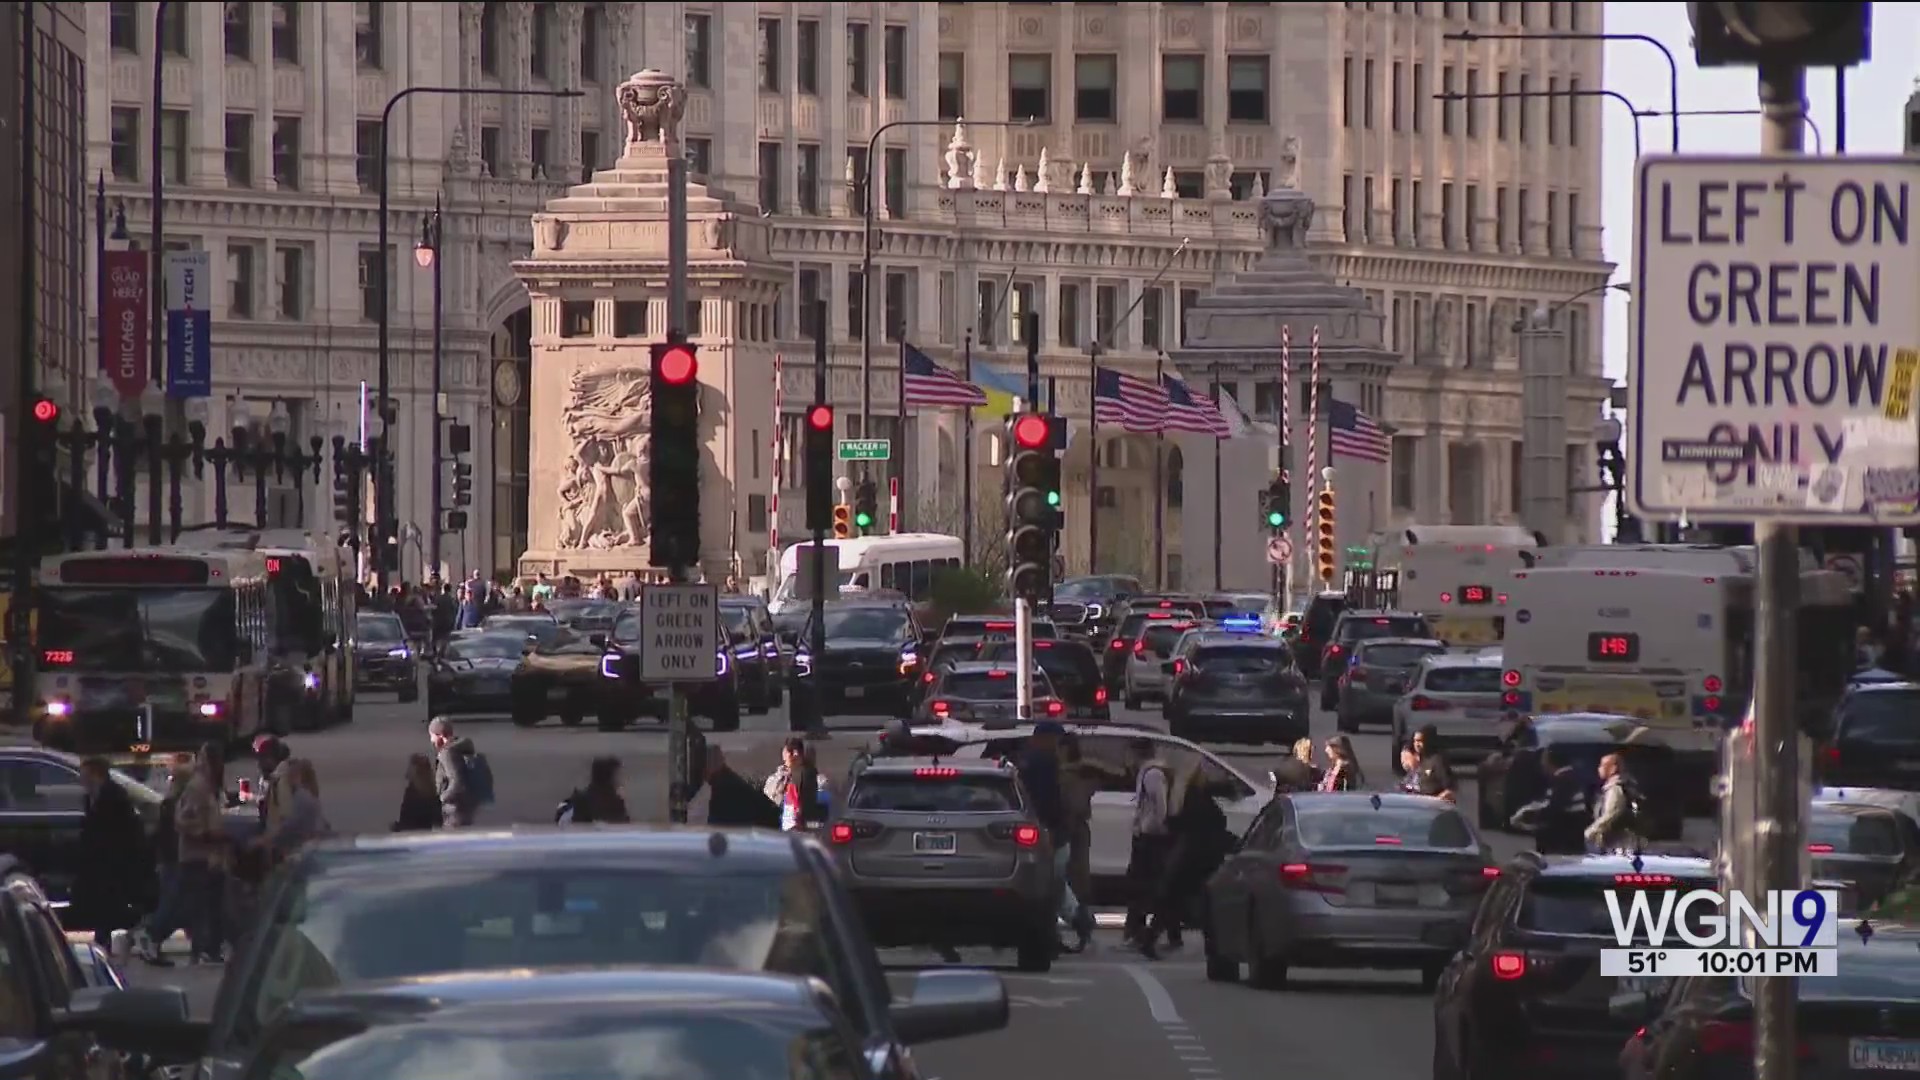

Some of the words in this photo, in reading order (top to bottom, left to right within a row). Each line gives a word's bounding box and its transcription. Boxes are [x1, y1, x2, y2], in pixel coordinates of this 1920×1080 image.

[1661, 179, 1806, 245] LEFT
[1830, 179, 1910, 246] ON
[111, 271, 140, 282] GLAD
[184, 268, 194, 303] TECH
[1687, 260, 1880, 326] GREEN
[121, 309, 135, 378] CHICAGO
[184, 317, 194, 373] HEALTH
[1676, 342, 1888, 407] ARROW
[649, 593, 681, 608] LEFT
[690, 593, 709, 608] ON
[656, 612, 703, 628] GREEN
[655, 634, 704, 649] ARROW
[661, 655, 697, 670] ONLY
